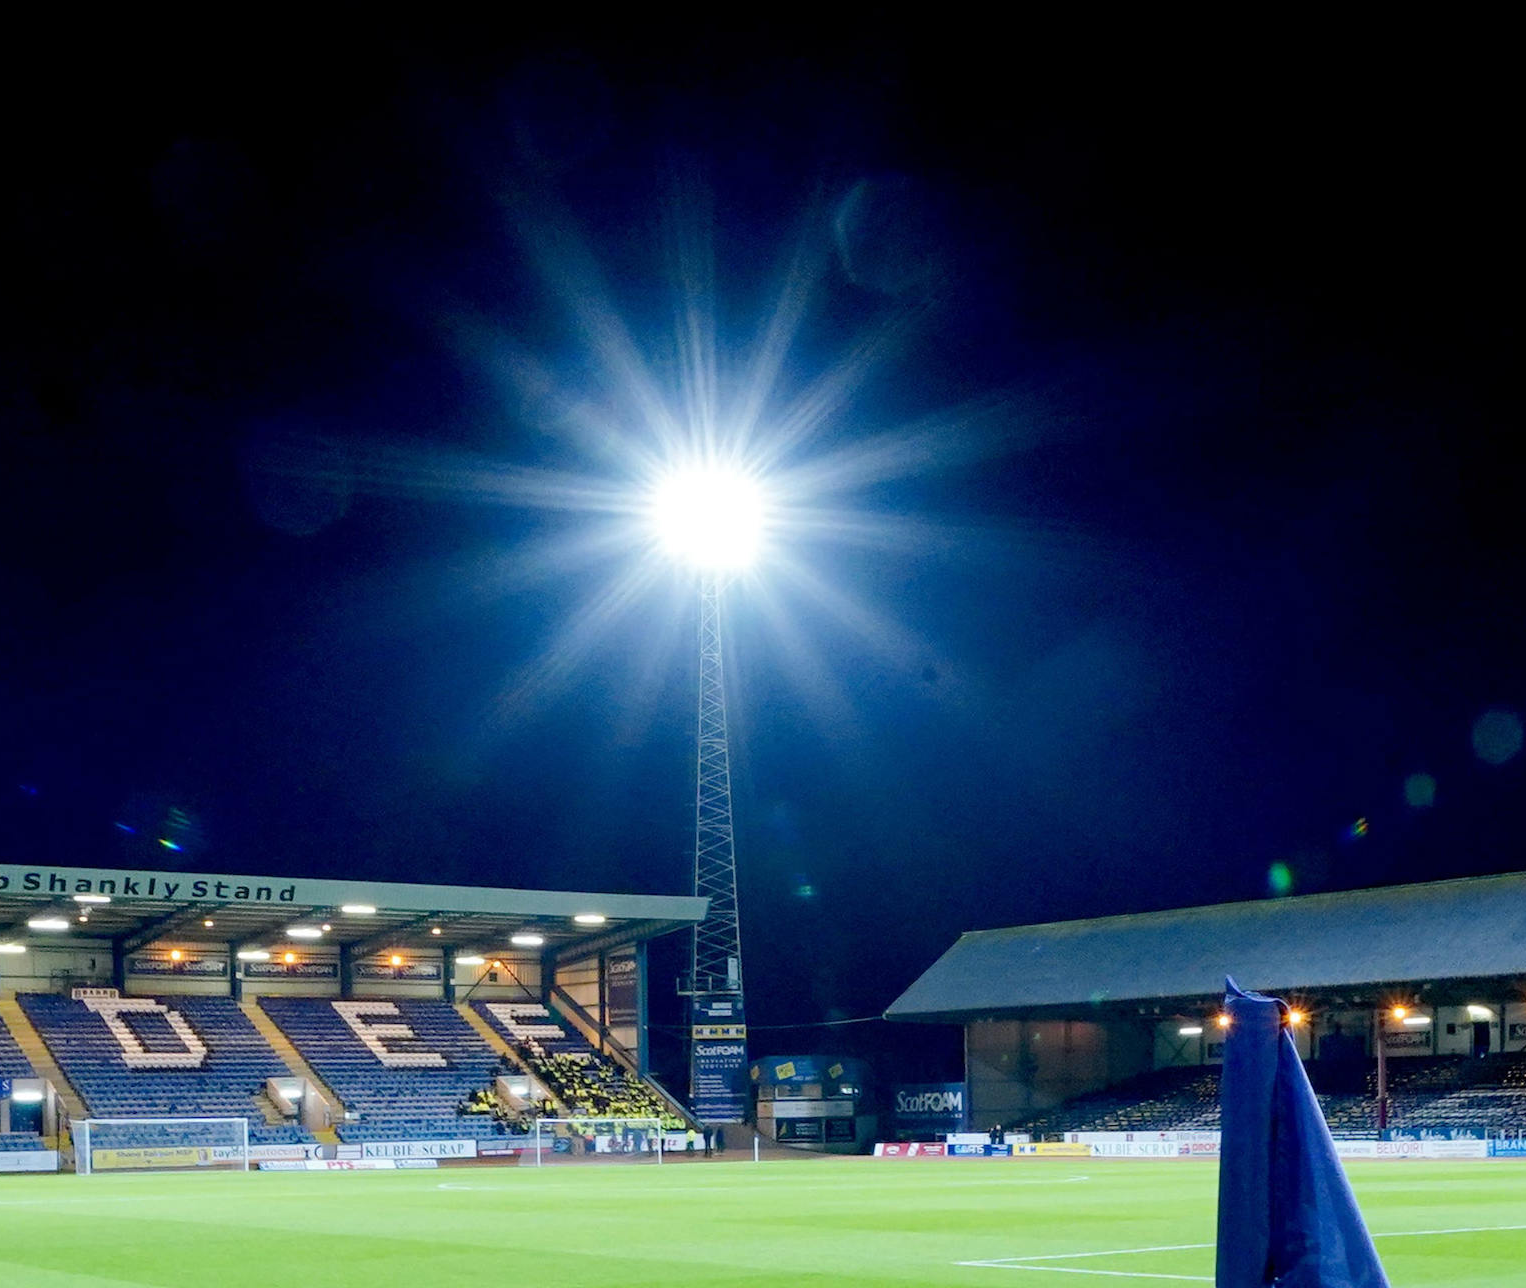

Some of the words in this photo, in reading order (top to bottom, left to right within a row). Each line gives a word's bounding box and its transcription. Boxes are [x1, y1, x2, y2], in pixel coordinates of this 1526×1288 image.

[24, 872, 179, 899] Shankly
[193, 880, 296, 902] Stand
[695, 1044, 745, 1057] ScotFOAM
[896, 1091, 962, 1112] ScotFOAM
[424, 1142, 464, 1157] SCRAP
